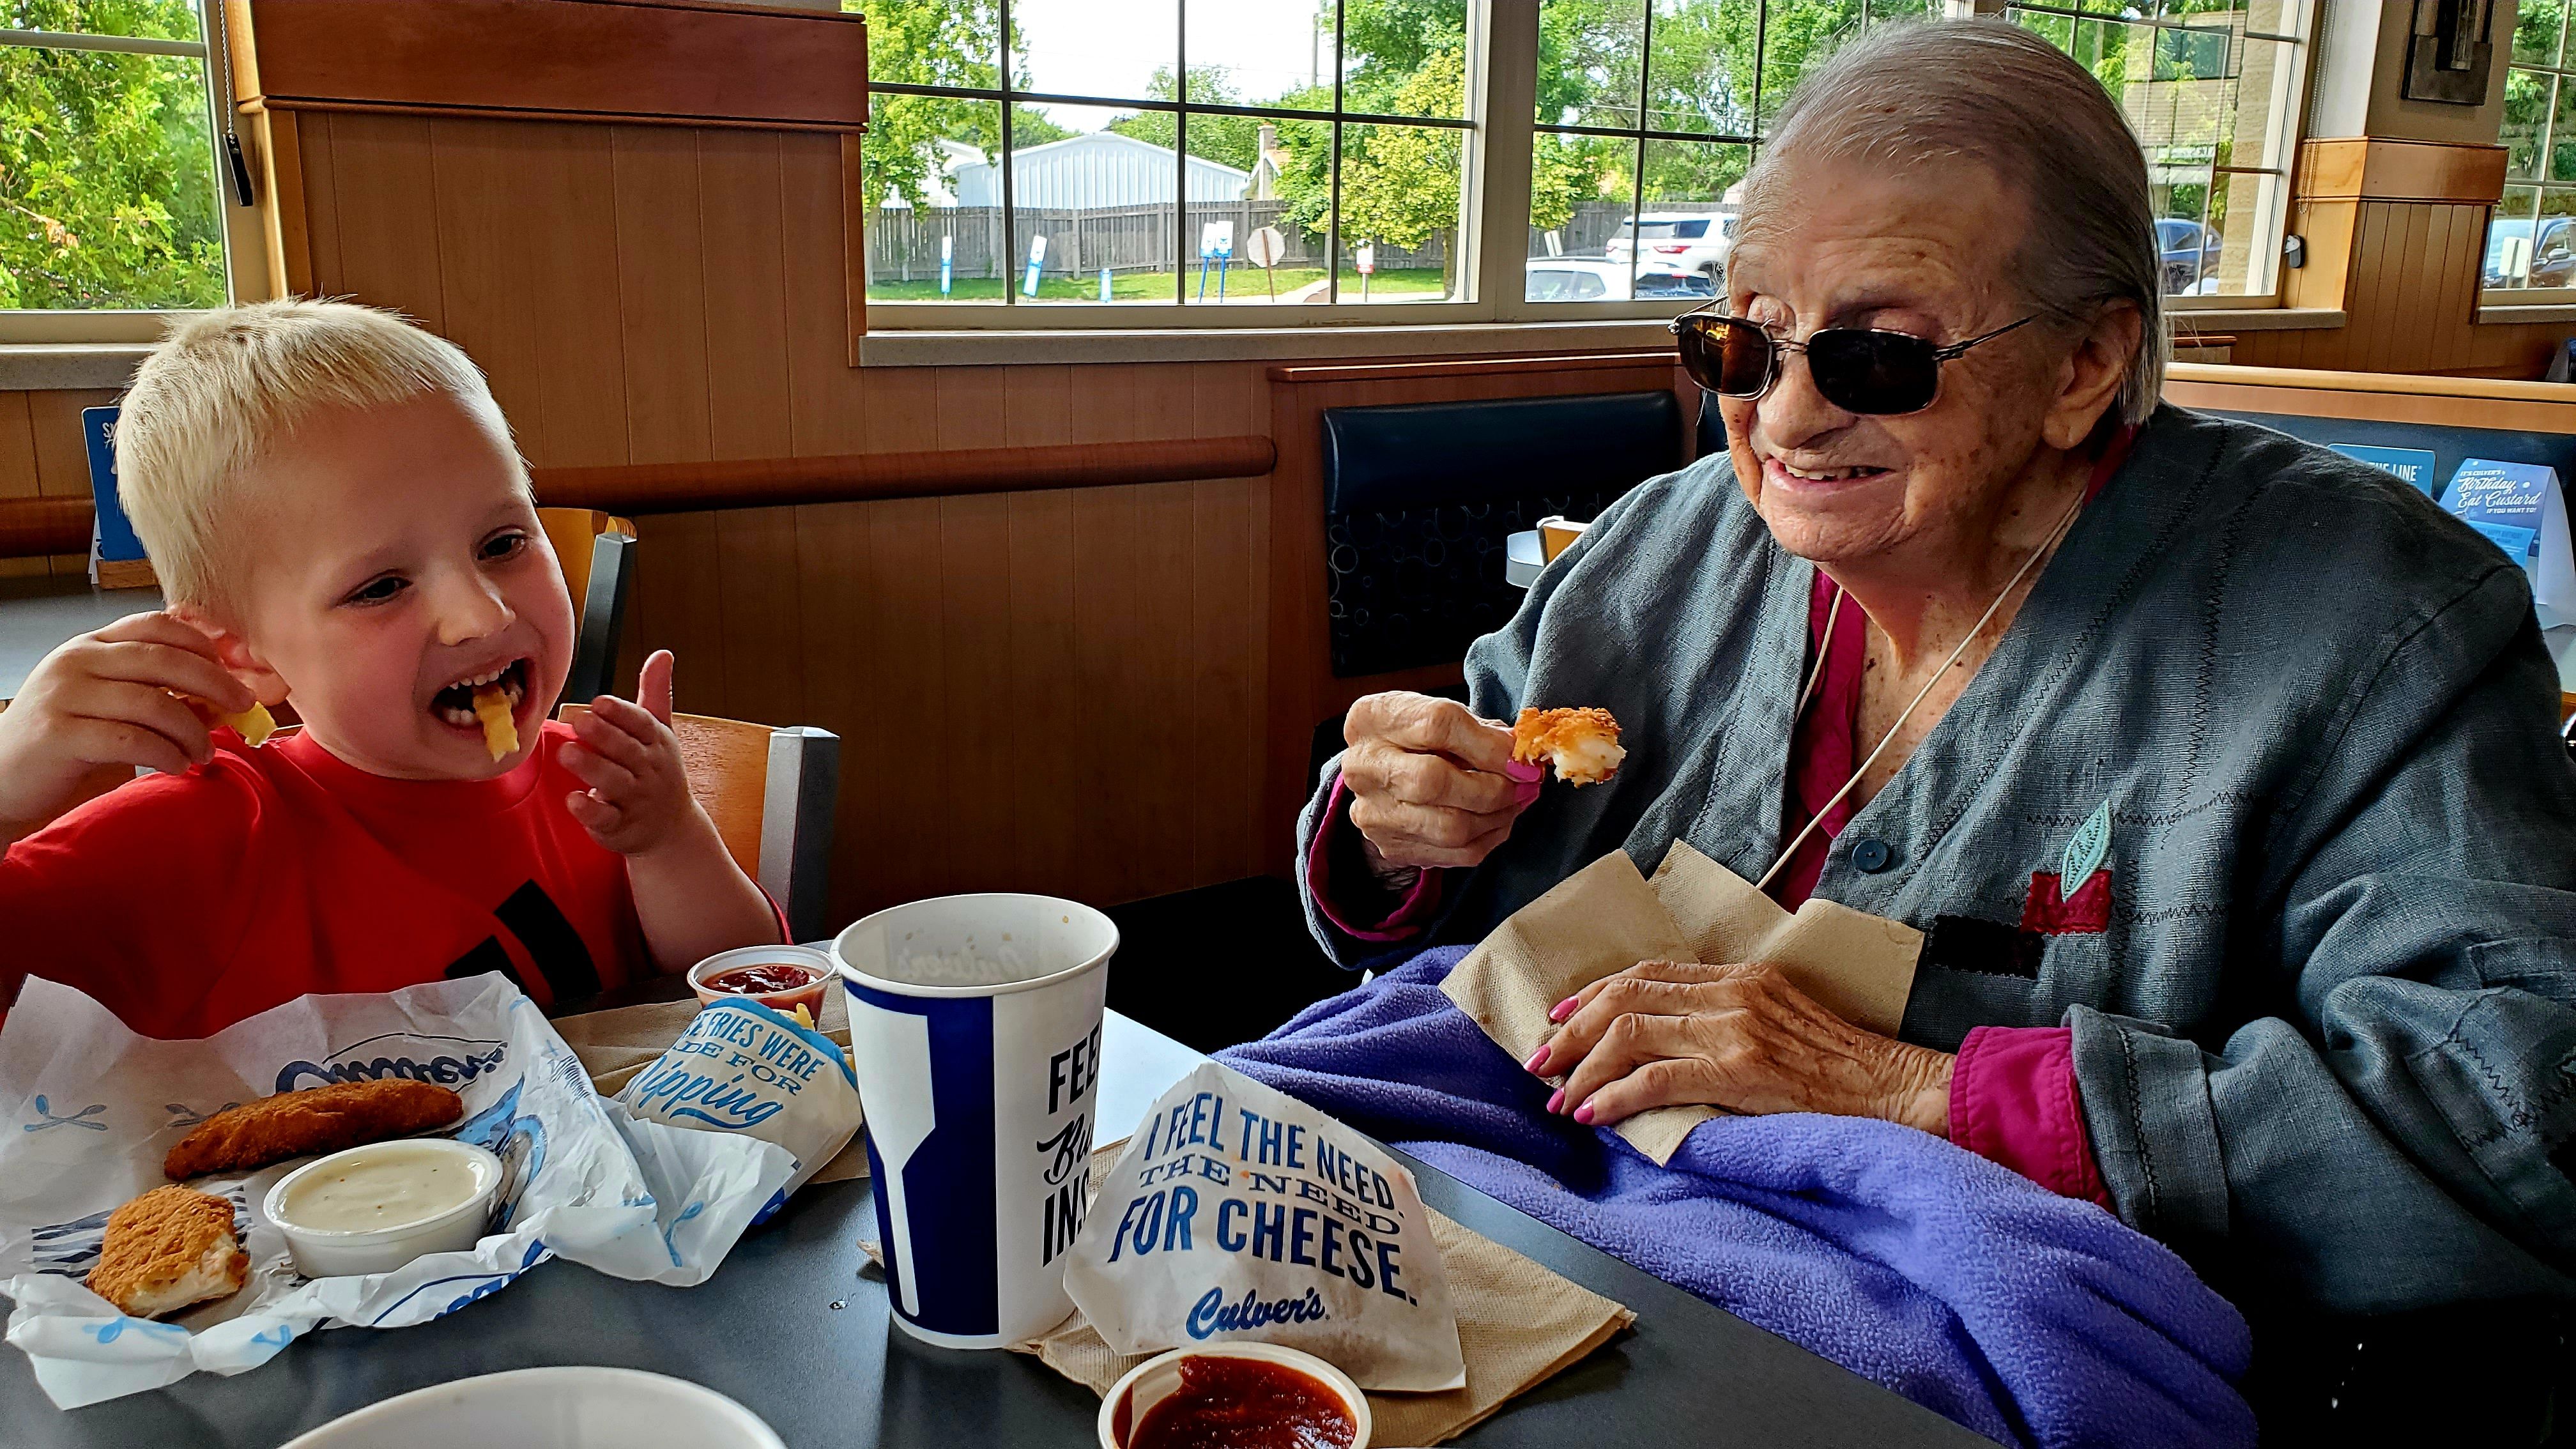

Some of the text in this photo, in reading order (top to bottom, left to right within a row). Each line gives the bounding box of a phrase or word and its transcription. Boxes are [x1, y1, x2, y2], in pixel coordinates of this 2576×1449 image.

[2458, 491, 2542, 508] Eat Custard
[702, 1011, 763, 1048] FRIES
[758, 1031, 825, 1082] WERE
[726, 1051, 803, 1096] FOR
[1048, 1018, 1102, 1115] FEE
[1144, 1112, 1162, 1161] I
[1162, 1092, 1225, 1161] FEEL
[1239, 1107, 1306, 1170] THE
[1139, 1153, 1402, 1236] THE NEED
[1107, 1185, 1418, 1307] FOR CHEESE.
[1186, 1286, 1326, 1340] Culver's
